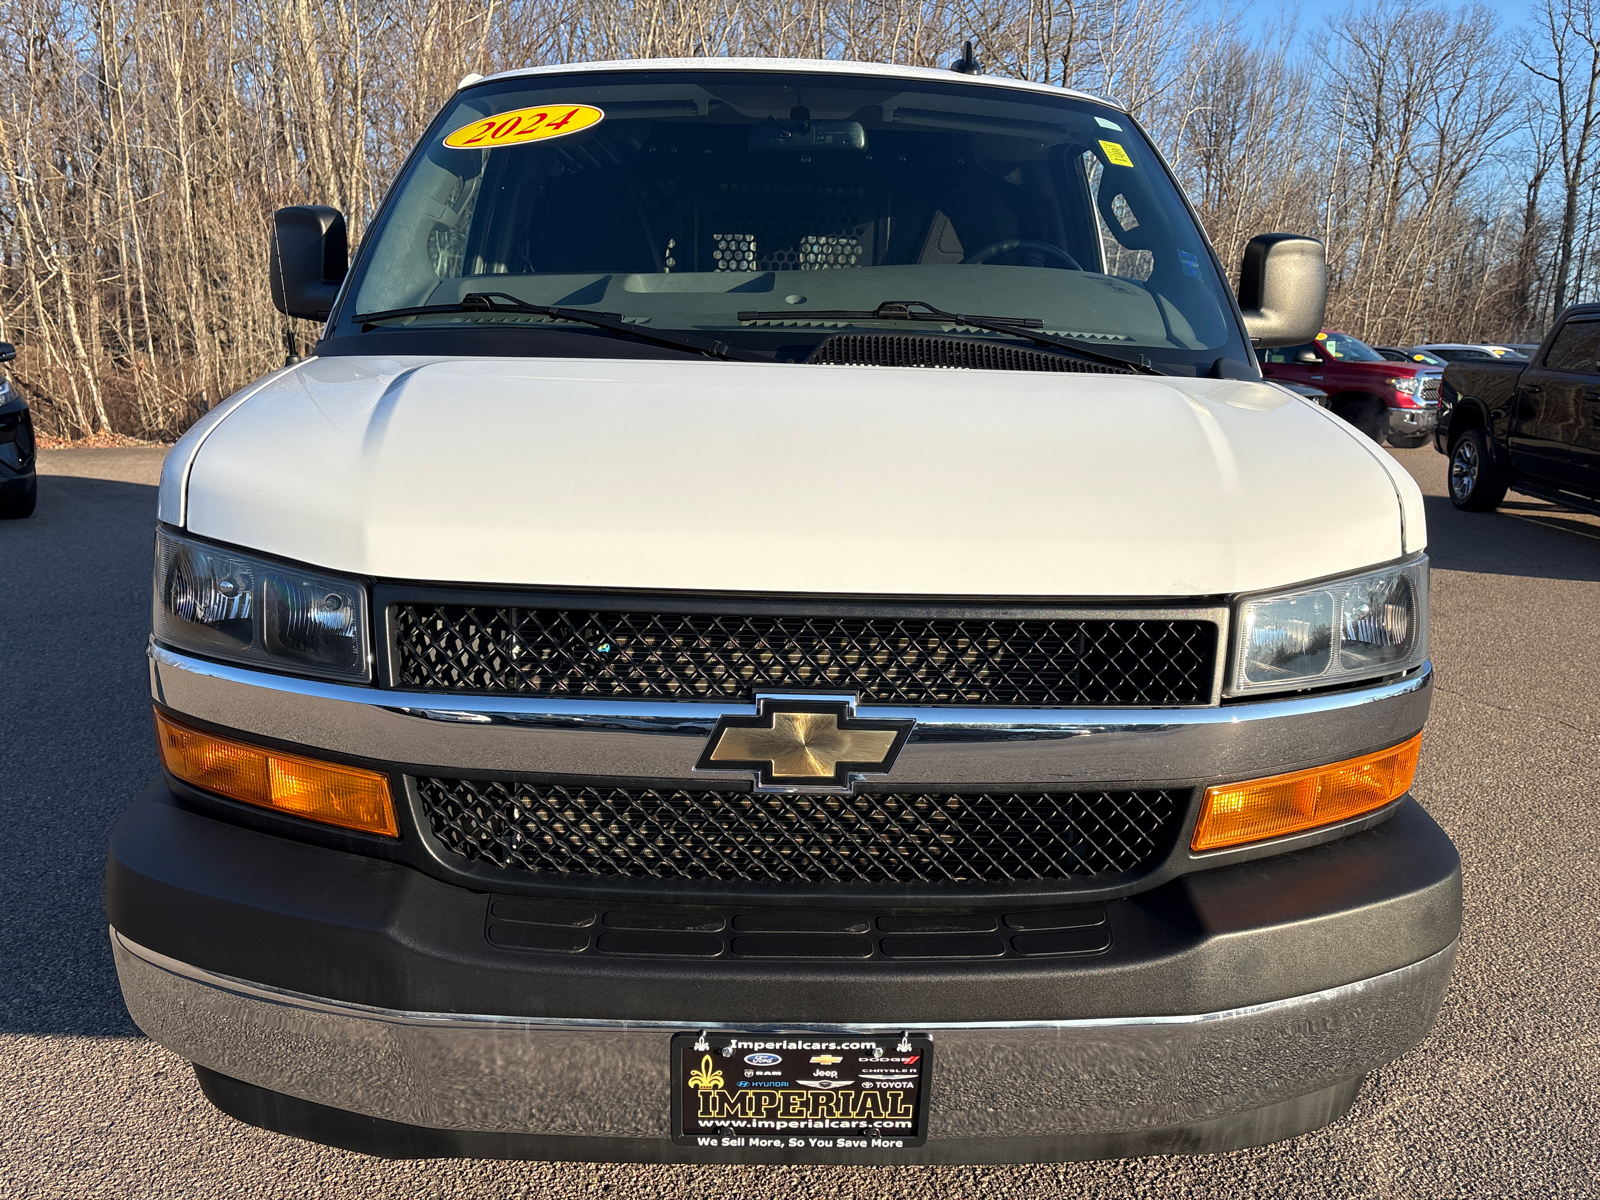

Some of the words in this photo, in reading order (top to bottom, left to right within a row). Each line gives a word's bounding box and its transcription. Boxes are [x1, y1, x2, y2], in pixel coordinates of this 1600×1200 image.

[462, 108, 581, 145] 2024
[730, 1039, 876, 1051] Imperialcars.com
[813, 1069, 838, 1078] Jeep
[875, 1081, 914, 1089] TOYOTA
[697, 1090, 913, 1119] IMPERIAL
[698, 1118, 912, 1130] www.imperialcars.com
[697, 1137, 718, 1147] We
[721, 1137, 746, 1147] Sell
[749, 1138, 785, 1148] More,
[788, 1138, 805, 1148] So
[808, 1138, 833, 1148] You
[836, 1138, 867, 1148] Save
[871, 1138, 903, 1148] More
